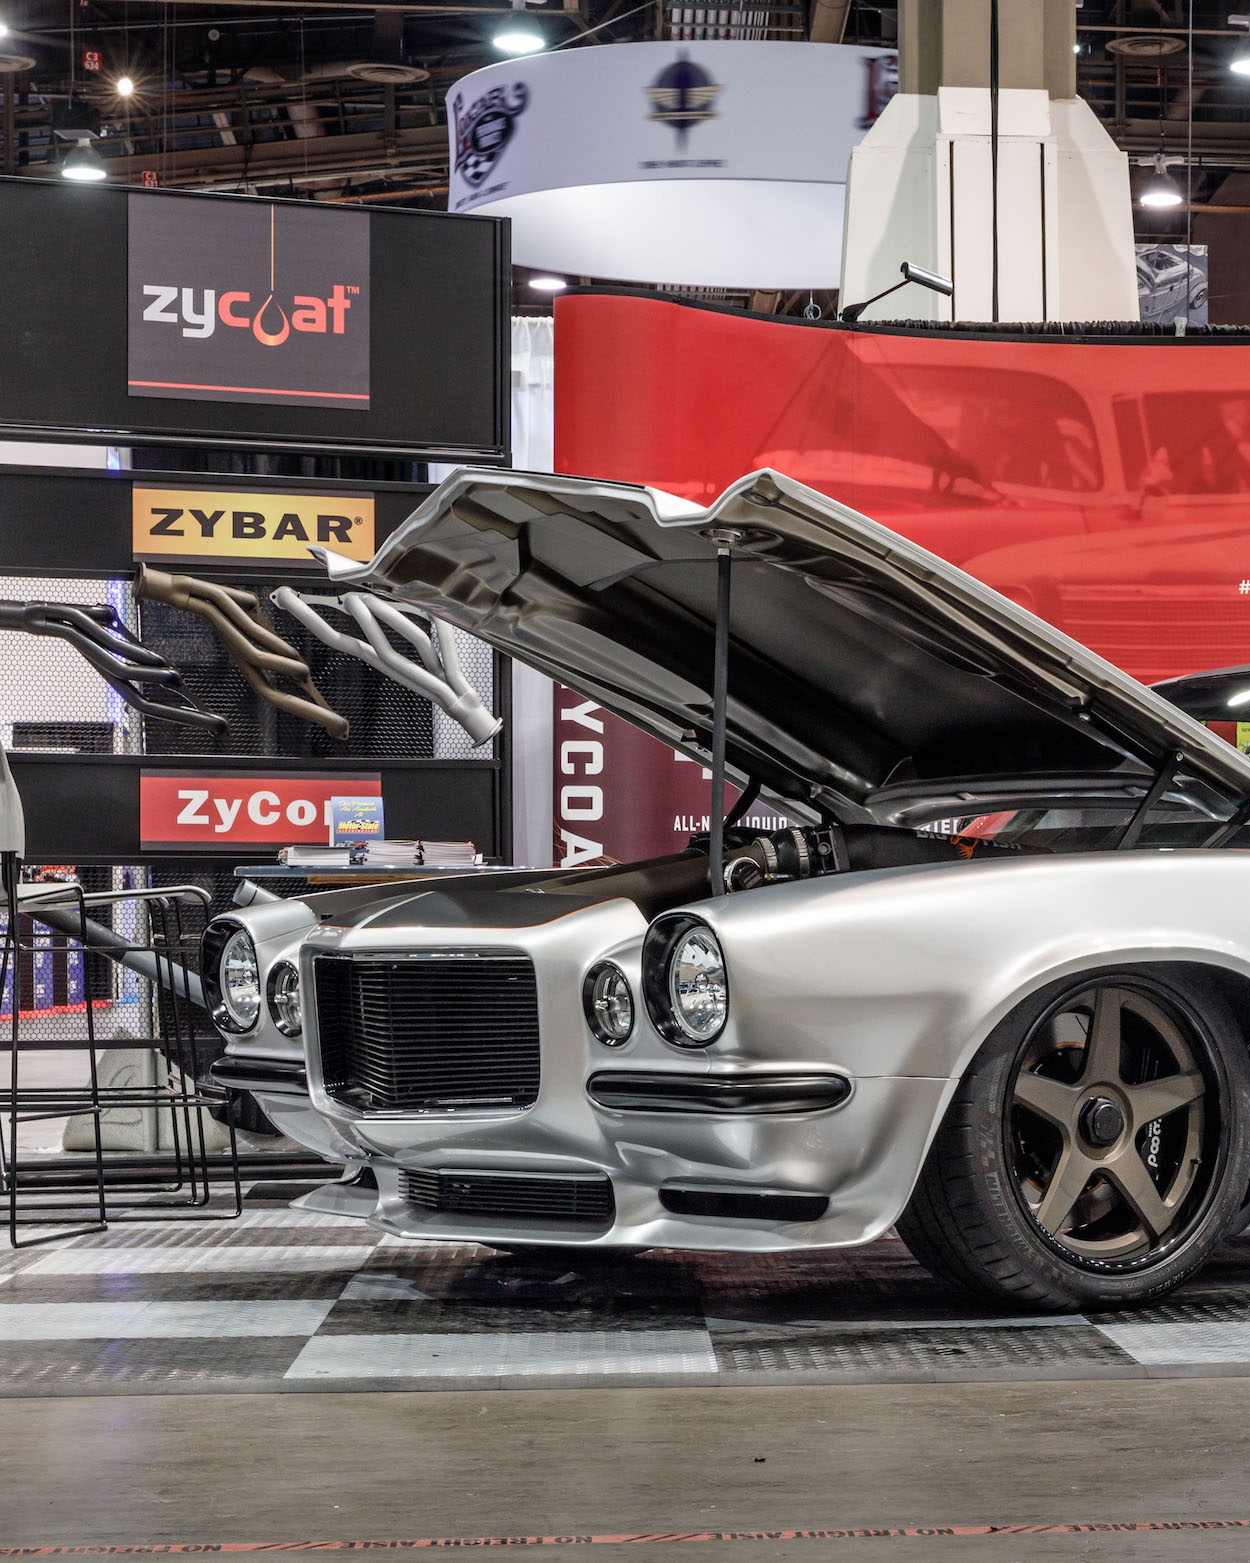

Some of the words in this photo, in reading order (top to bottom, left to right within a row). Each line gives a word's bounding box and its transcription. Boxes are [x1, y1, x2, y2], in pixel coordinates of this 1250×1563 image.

[85, 51, 99, 62] C3
[84, 61, 100, 71] 634
[145, 172, 158, 180] C3
[176, 789, 332, 833] ZyCo
[916, 1527, 955, 1536] NO
[1066, 1523, 1138, 1532] AISLE
[707, 1531, 783, 1541] AISLE
[791, 1528, 908, 1539] FREIGHT
[424, 1536, 544, 1547] FREIGHT
[553, 1535, 593, 1544] NO
[181, 1544, 221, 1552] NO
[340, 1540, 417, 1549] AISLE
